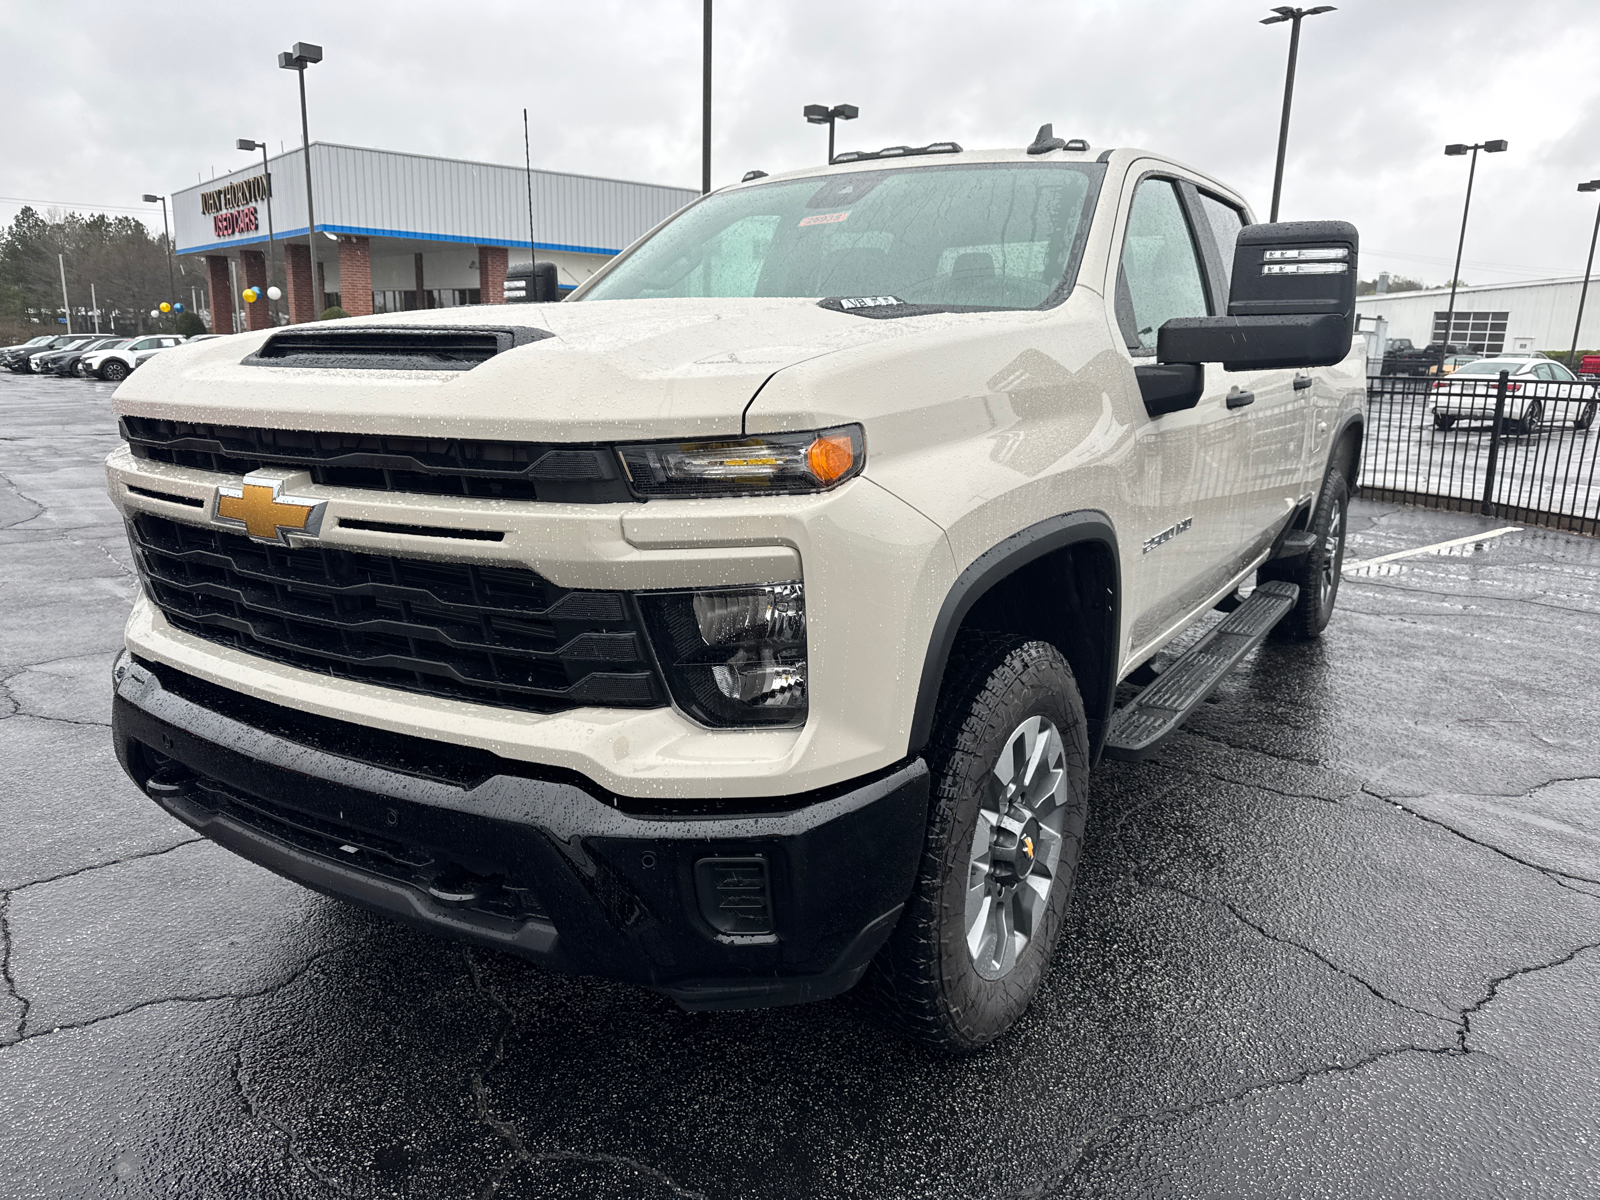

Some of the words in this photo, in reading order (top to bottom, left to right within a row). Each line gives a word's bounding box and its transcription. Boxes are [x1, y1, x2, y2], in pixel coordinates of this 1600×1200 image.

[200, 189, 223, 215] JOHN
[220, 172, 272, 210] THORNTON
[213, 212, 235, 237] USED
[233, 206, 259, 233] CARS
